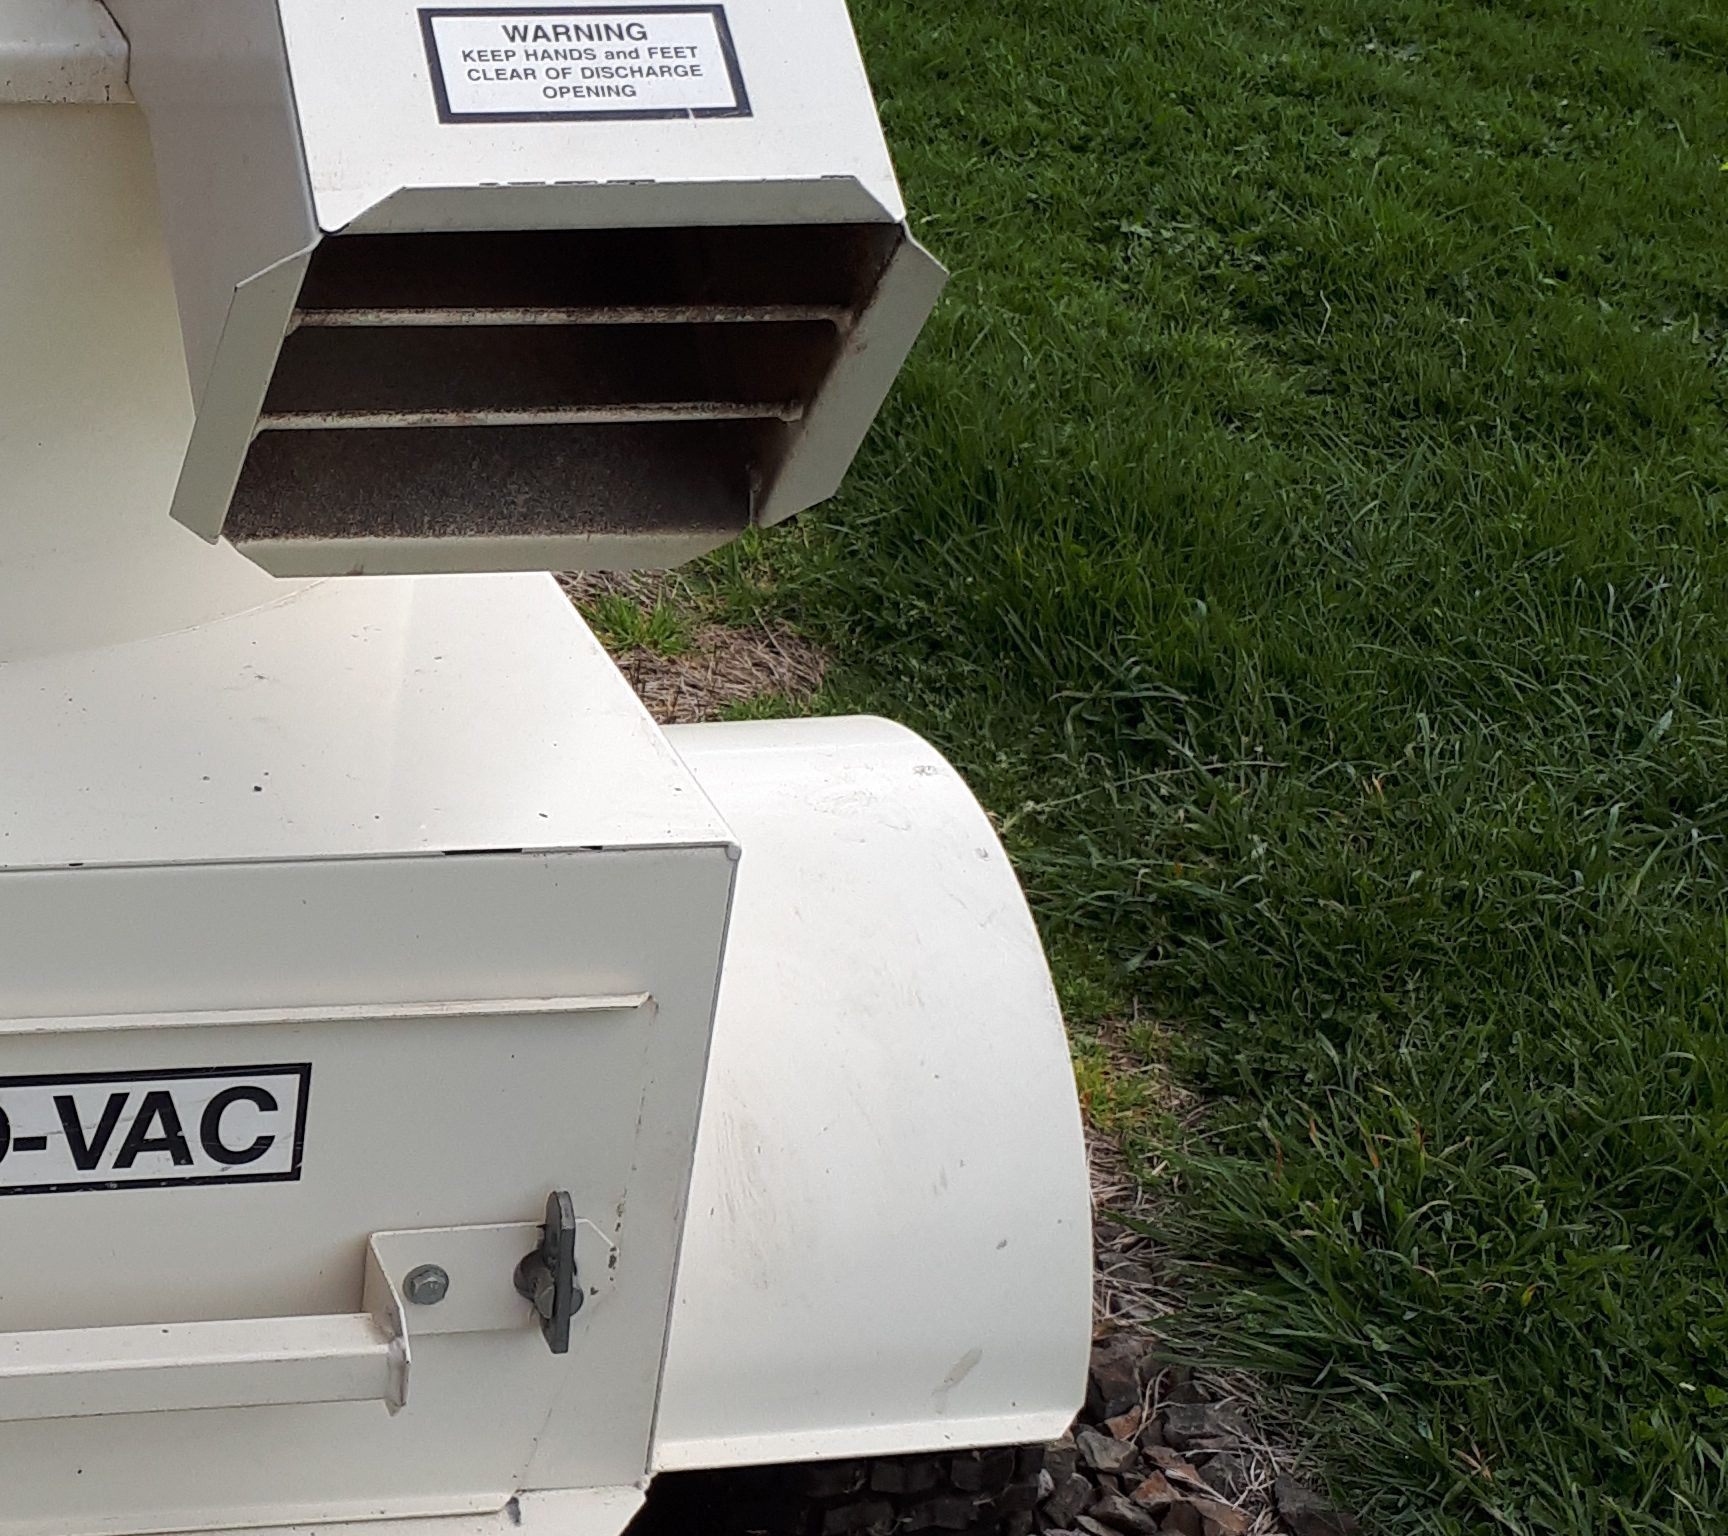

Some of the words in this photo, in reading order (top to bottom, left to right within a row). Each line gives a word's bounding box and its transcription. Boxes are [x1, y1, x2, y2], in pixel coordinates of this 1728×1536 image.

[501, 22, 649, 44] WARNING
[461, 49, 517, 63] KEEP
[524, 47, 597, 62] HANDS
[604, 47, 640, 61] and
[648, 45, 699, 59] FEET
[467, 67, 537, 82] CLEAR
[545, 67, 573, 80] OF
[581, 64, 704, 80] DISCHARGE
[542, 84, 637, 99] OPENING
